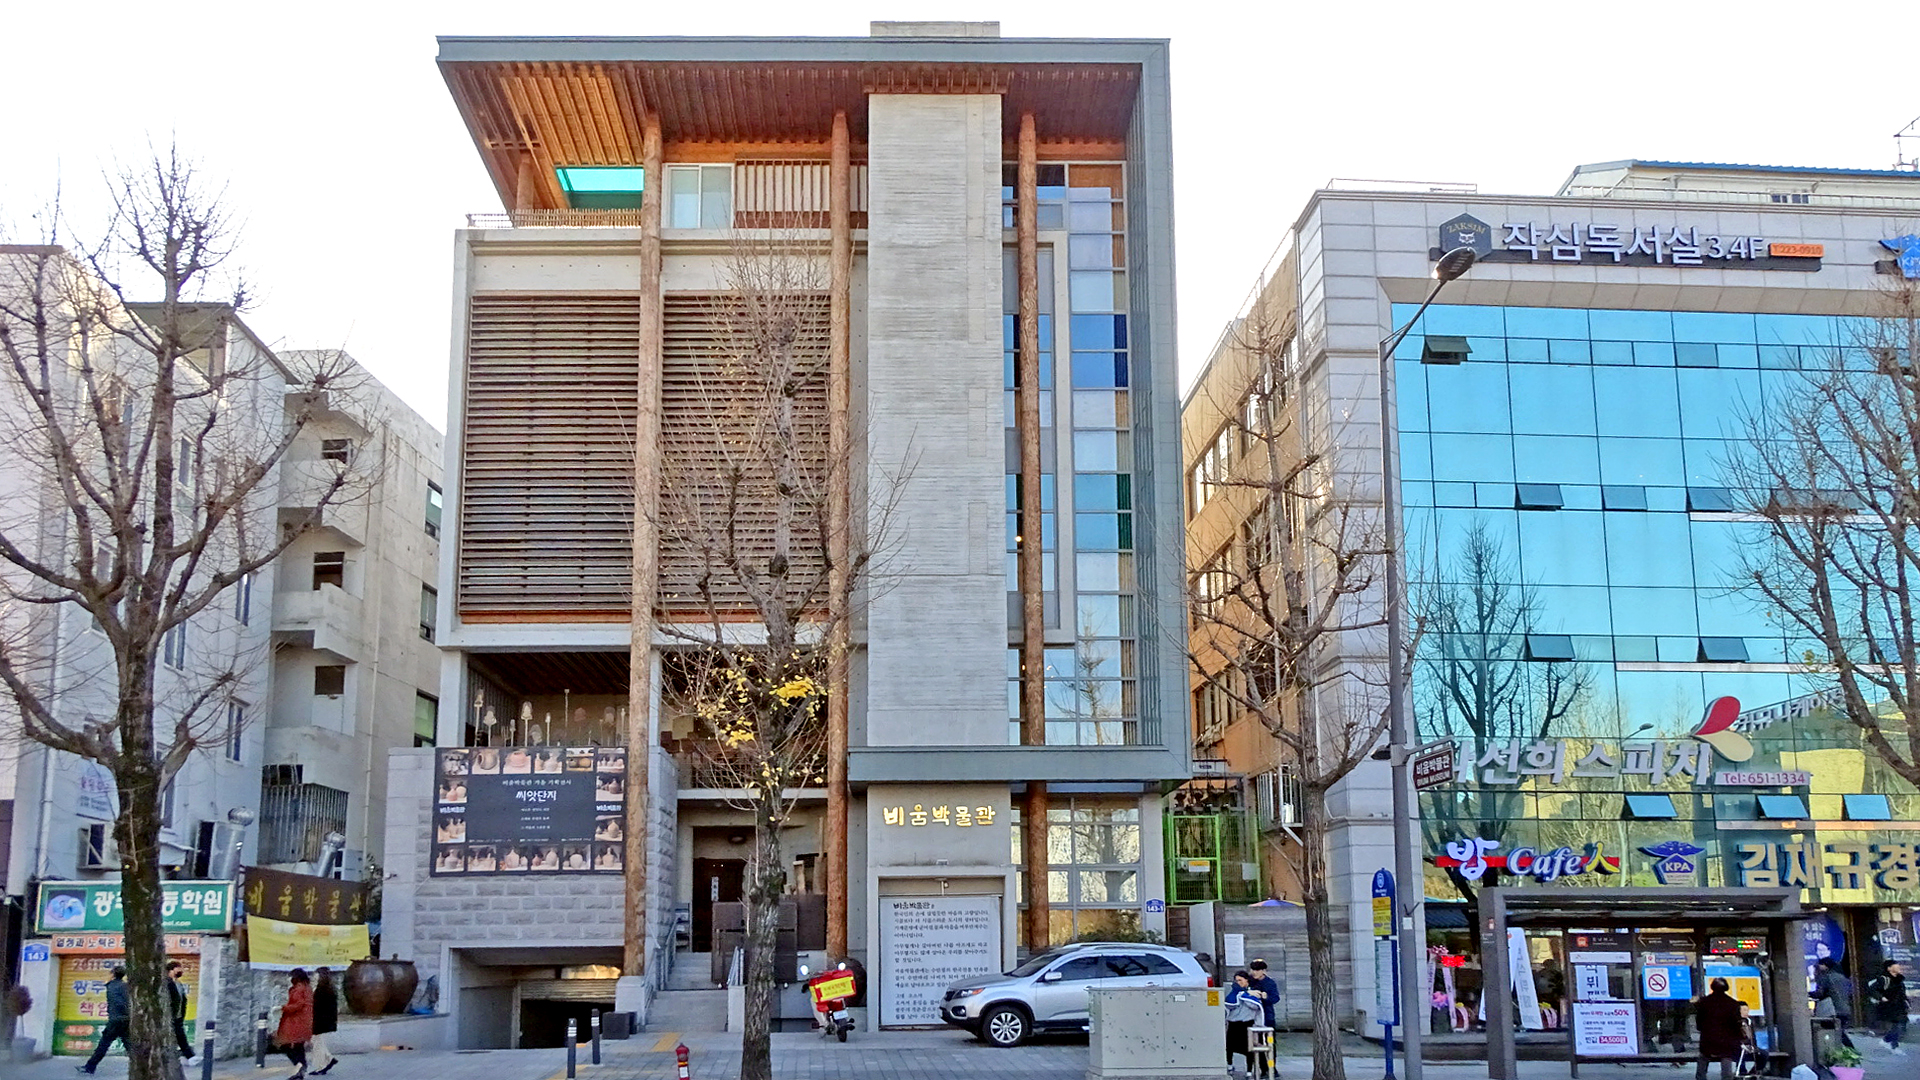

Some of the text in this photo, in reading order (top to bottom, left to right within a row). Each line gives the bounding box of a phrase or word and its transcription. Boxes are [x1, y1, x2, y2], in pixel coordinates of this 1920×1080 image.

[1446, 222, 1486, 234] ZAKSIM
[1502, 220, 1702, 265] 작심독서실
[1416, 754, 1451, 776] 비움박물관
[1573, 742, 1712, 786] 스피치
[1430, 770, 1452, 783] MUSEUM
[515, 789, 557, 802] 씨앗단지
[882, 803, 996, 827] 비움박물관
[1506, 845, 1582, 882] Cafe
[1665, 861, 1691, 873] KPA
[1741, 842, 1916, 890] 김재규경
[93, 889, 223, 917] 광등학원
[26, 951, 45, 962] 143
